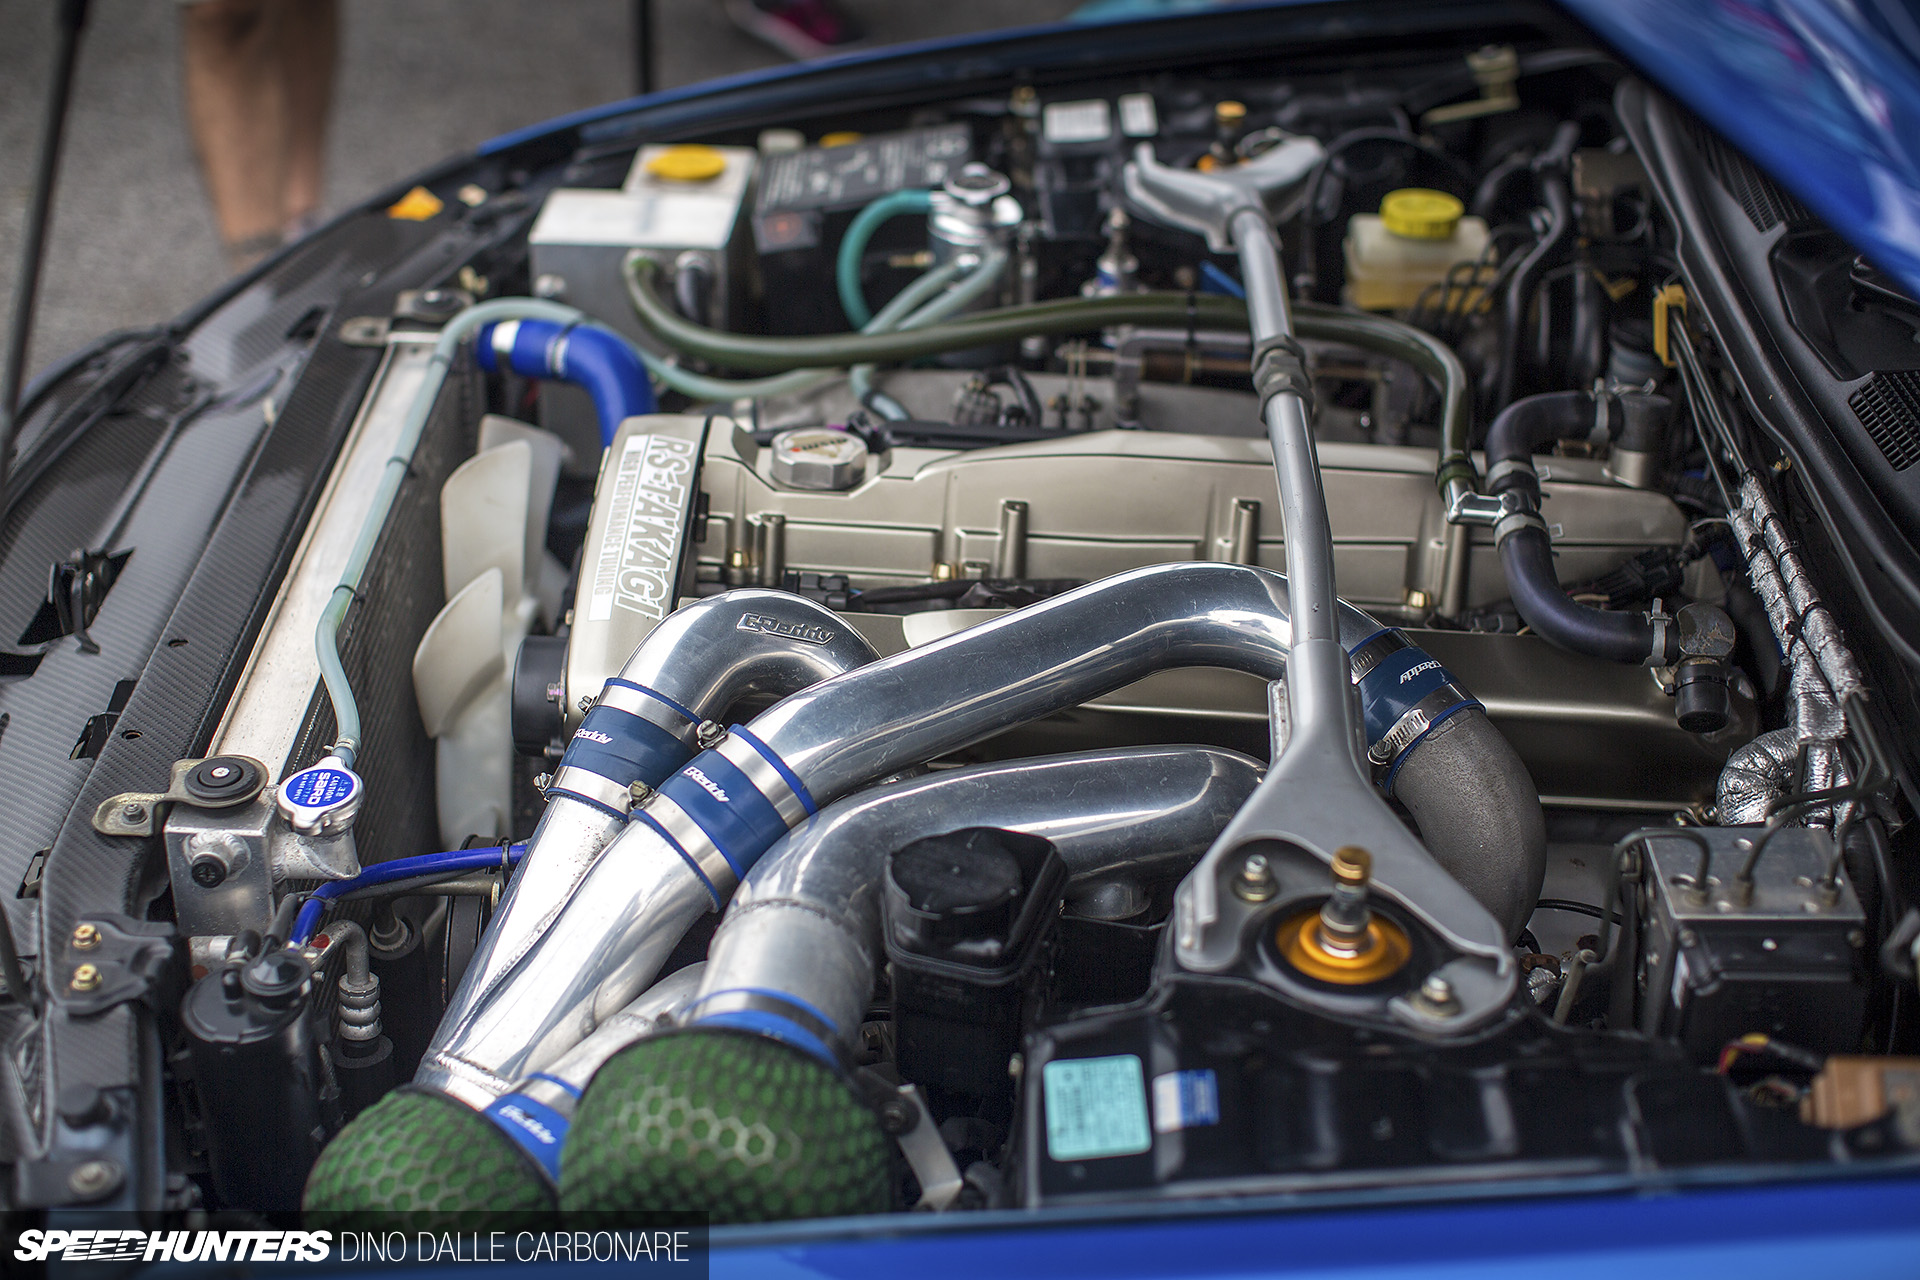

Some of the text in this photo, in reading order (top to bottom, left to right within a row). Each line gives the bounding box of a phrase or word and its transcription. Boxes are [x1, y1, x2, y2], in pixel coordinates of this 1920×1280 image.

[604, 475, 636, 548] PERFORMANCE
[614, 433, 695, 620] RS-TAKAGI
[595, 547, 619, 595] TUNING
[736, 612, 835, 645] GReddy
[683, 765, 731, 802] GReddy
